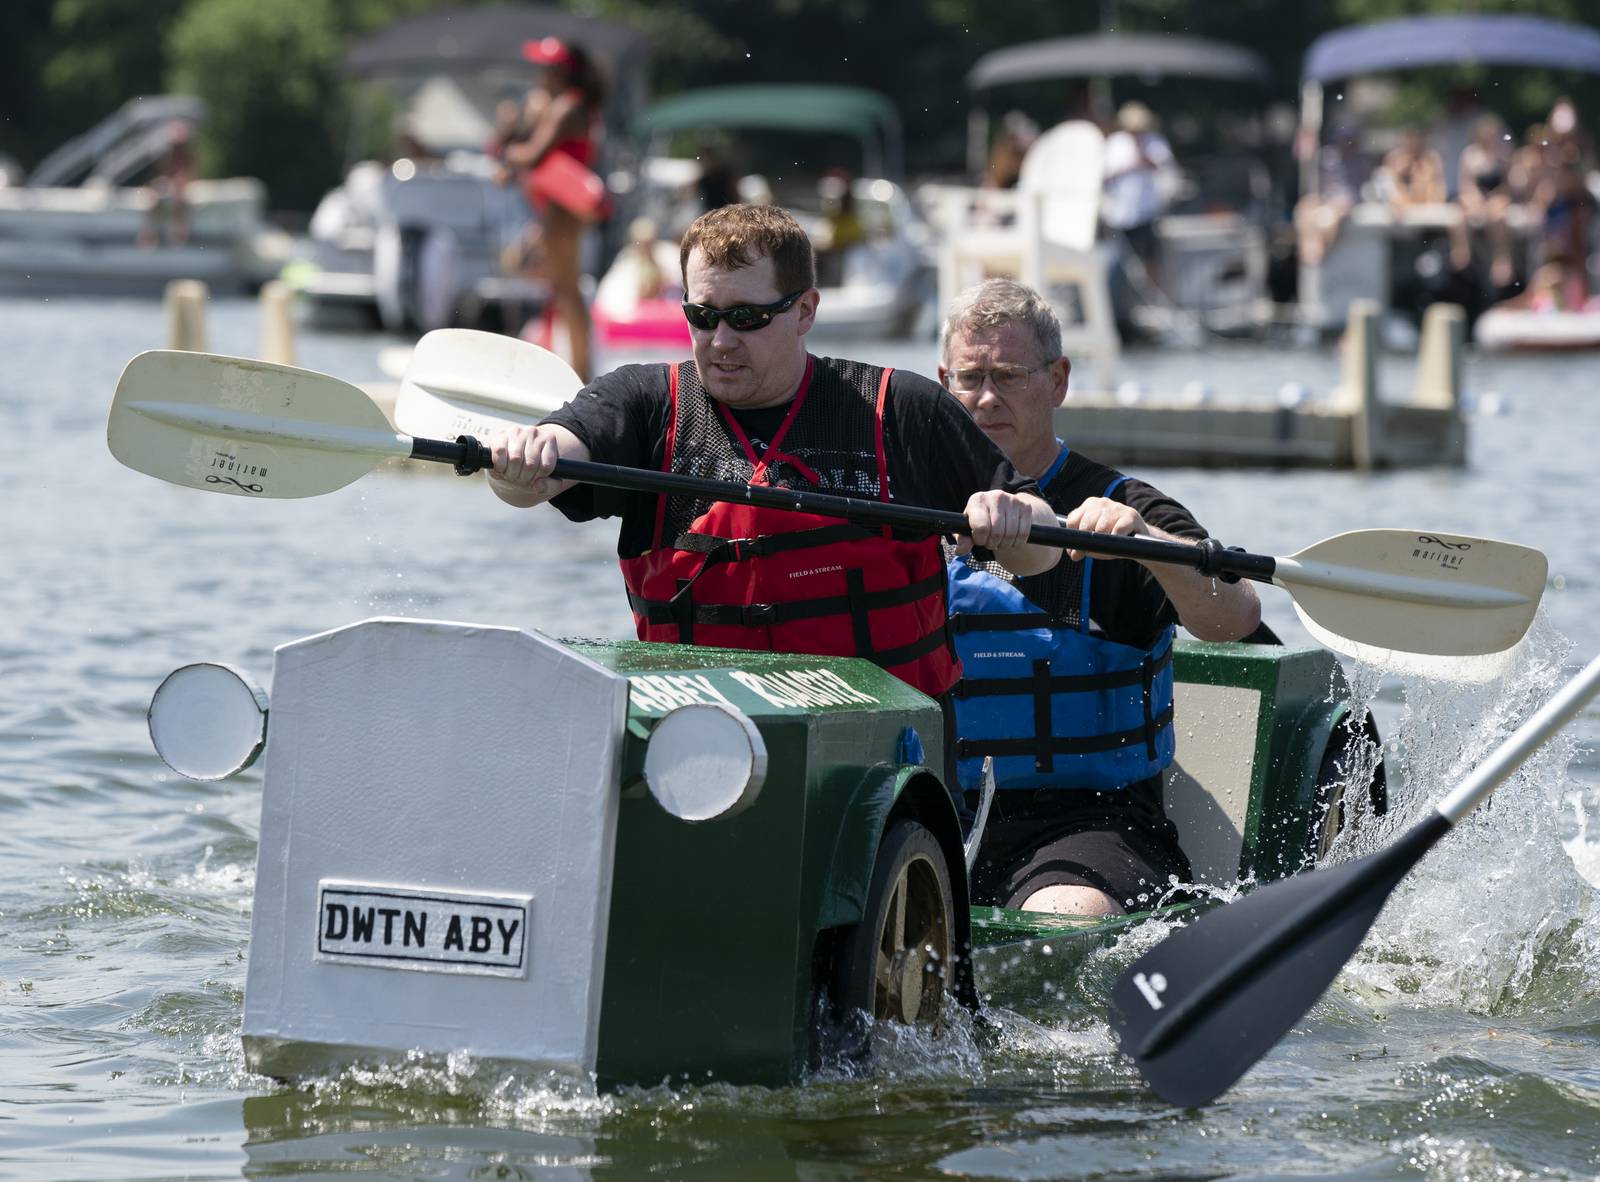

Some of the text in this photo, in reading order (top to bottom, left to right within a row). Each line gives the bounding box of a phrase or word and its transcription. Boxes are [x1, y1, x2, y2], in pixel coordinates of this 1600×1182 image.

[211, 458, 268, 477] mariner
[1412, 549, 1464, 565] mariner
[789, 570, 809, 578] FIELD
[325, 903, 519, 955] DWTN ABY
